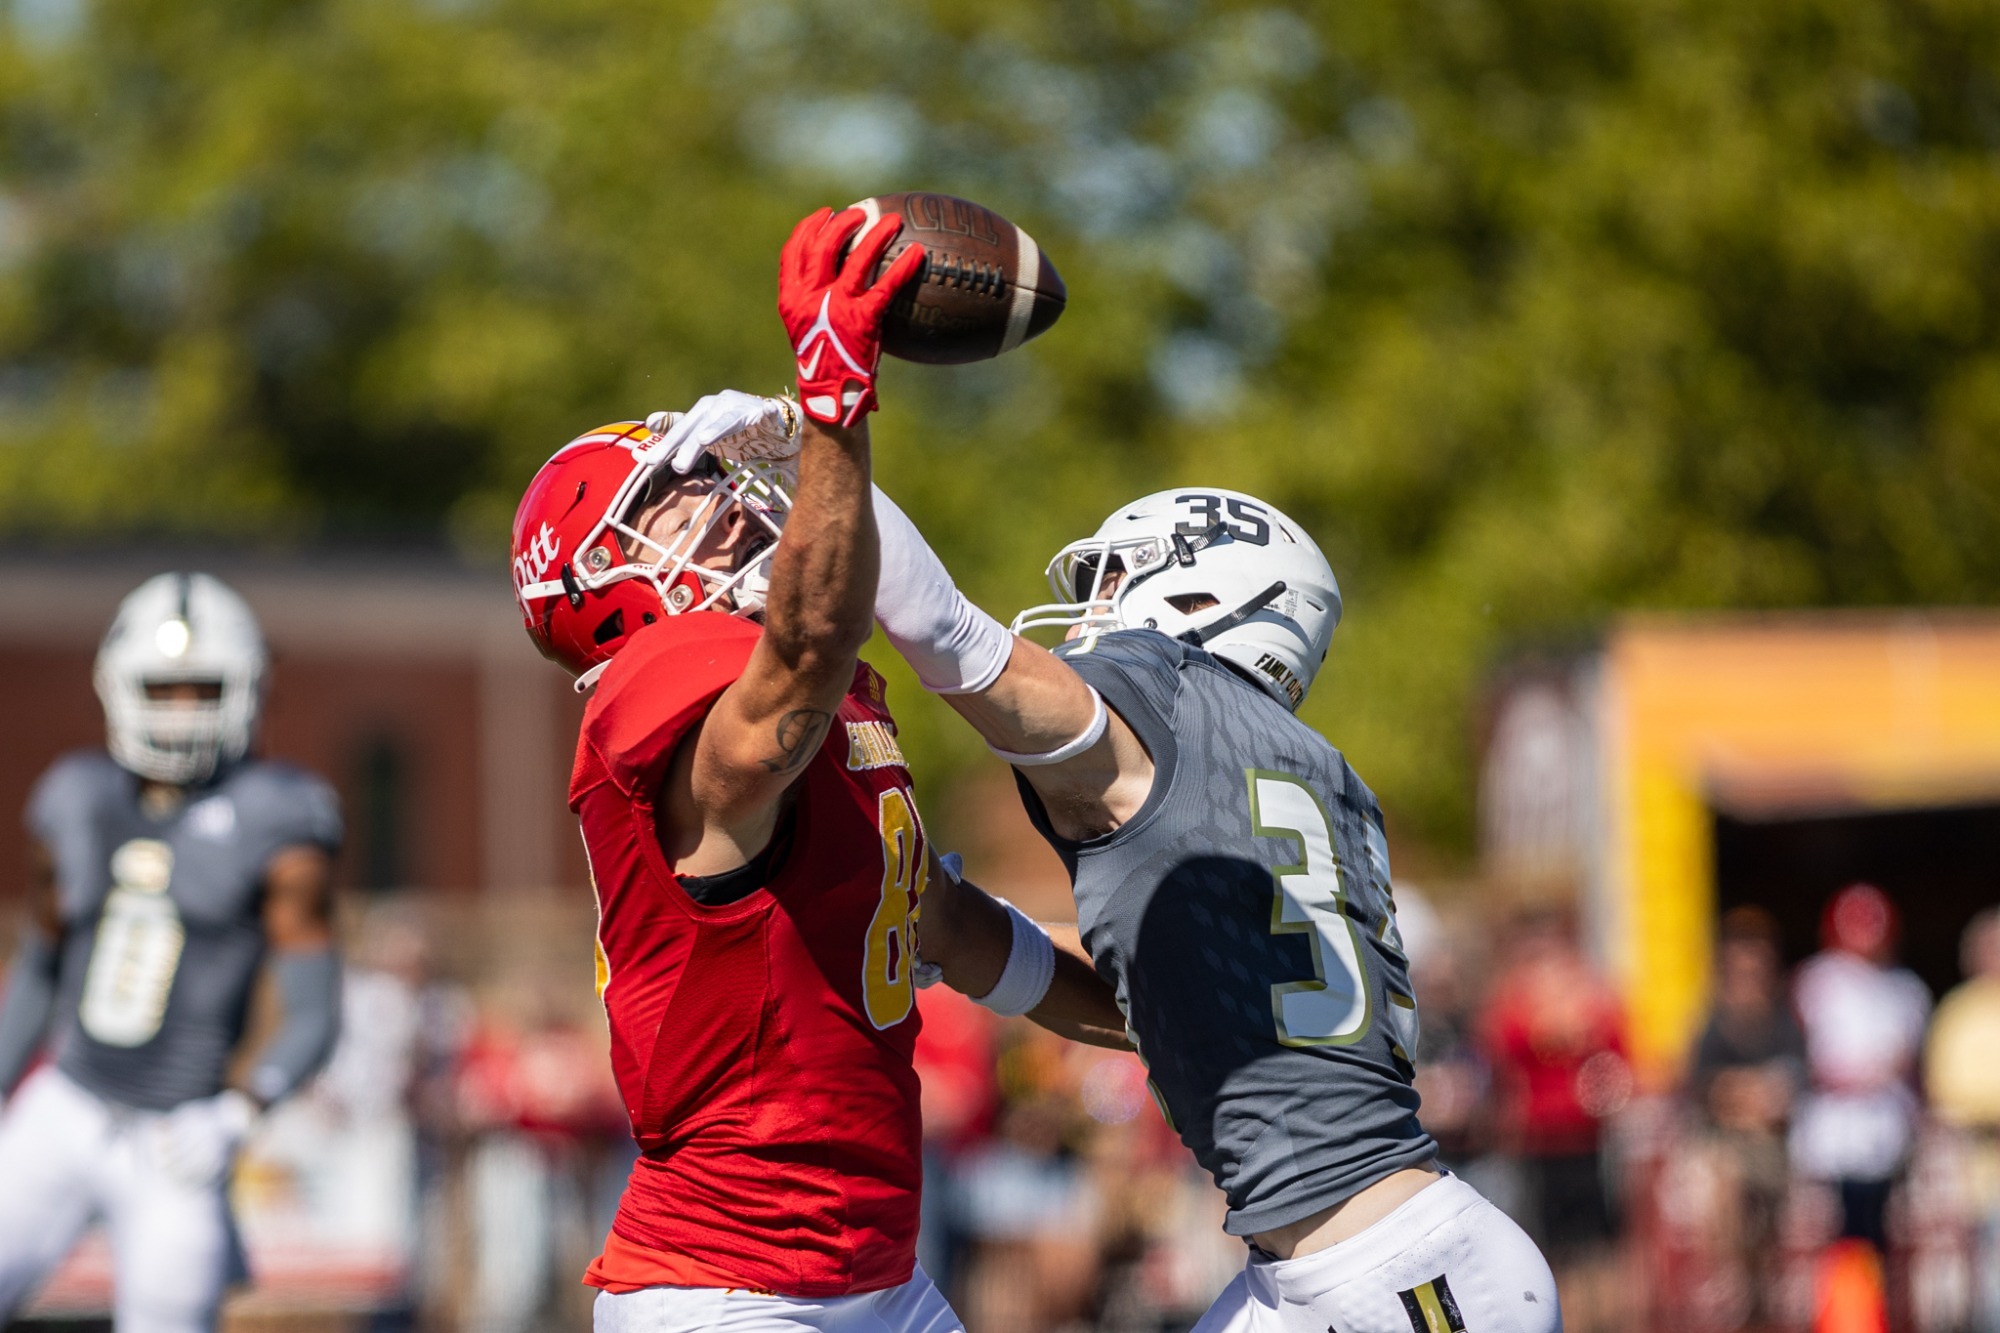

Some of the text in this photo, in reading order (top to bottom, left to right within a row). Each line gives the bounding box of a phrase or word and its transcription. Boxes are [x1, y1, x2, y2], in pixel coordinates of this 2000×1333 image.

[1175, 494, 1270, 547] 35
[513, 520, 561, 627] Pitt
[1254, 652, 1294, 685] FAMILY
